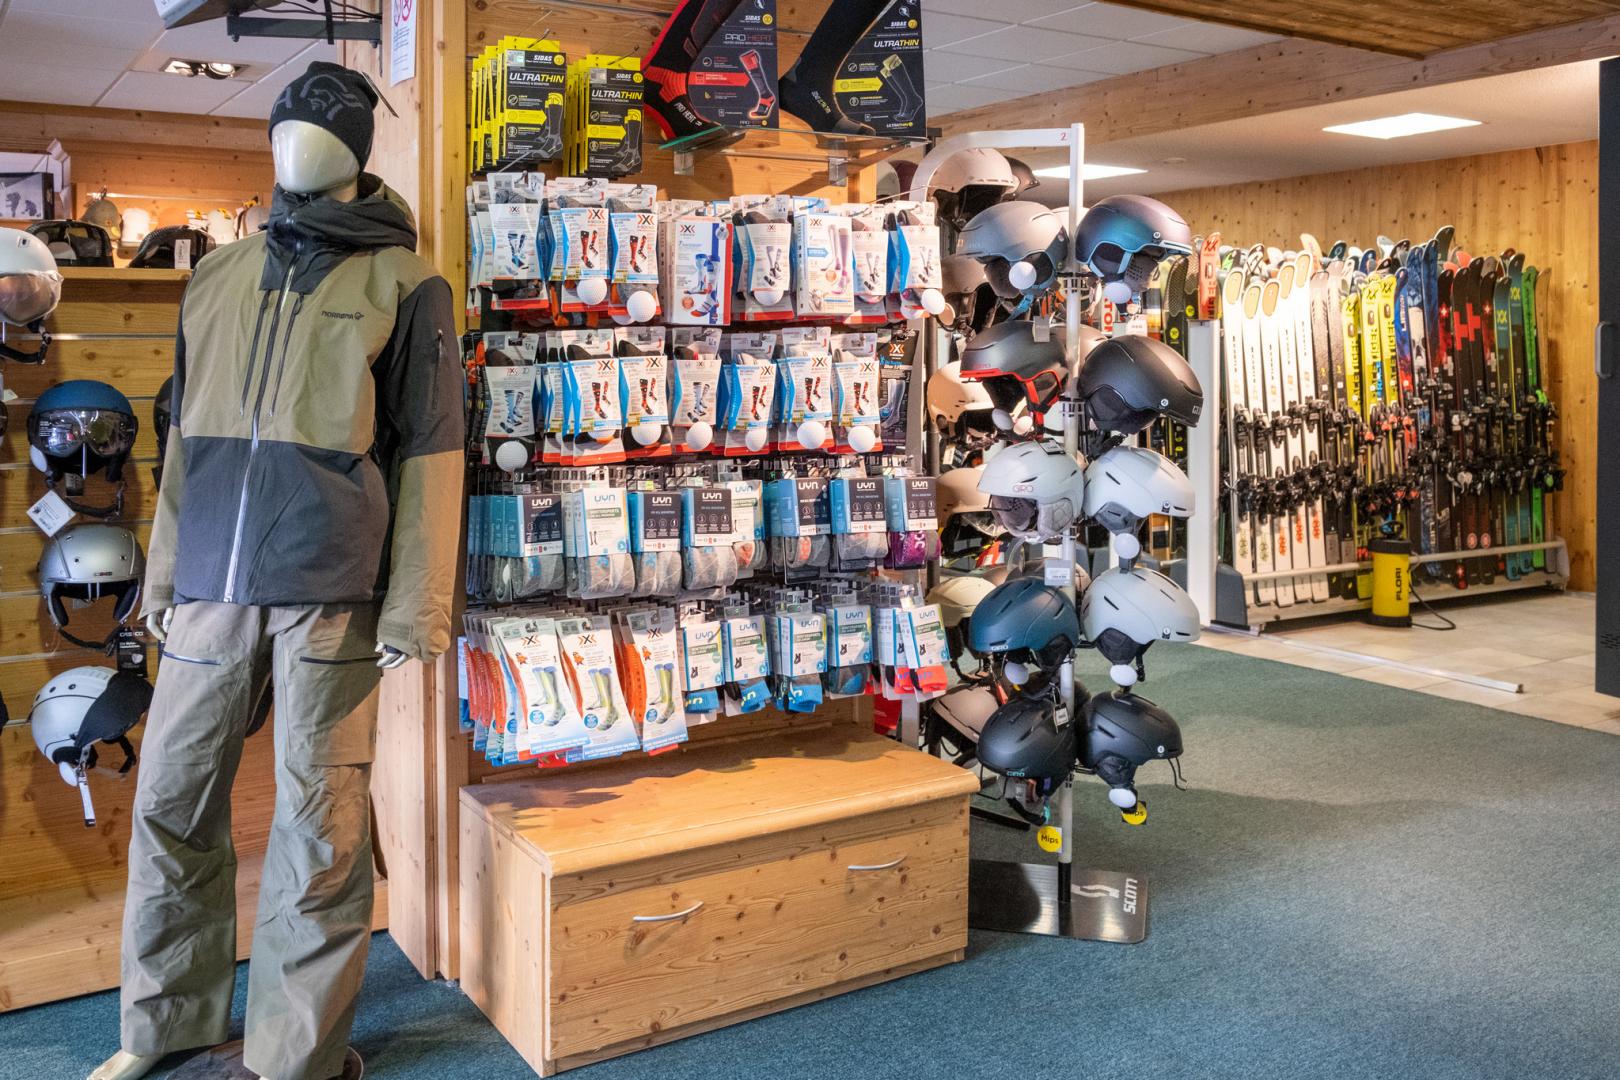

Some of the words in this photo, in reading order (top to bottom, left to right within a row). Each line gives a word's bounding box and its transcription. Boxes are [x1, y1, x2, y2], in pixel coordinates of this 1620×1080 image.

[873, 39, 920, 48] ULTRATHIN
[509, 72, 565, 83] ULTRATHIN
[591, 89, 643, 100] ULTRATHIN
[991, 644, 1009, 652] GIRO
[1041, 834, 1059, 844] Mips
